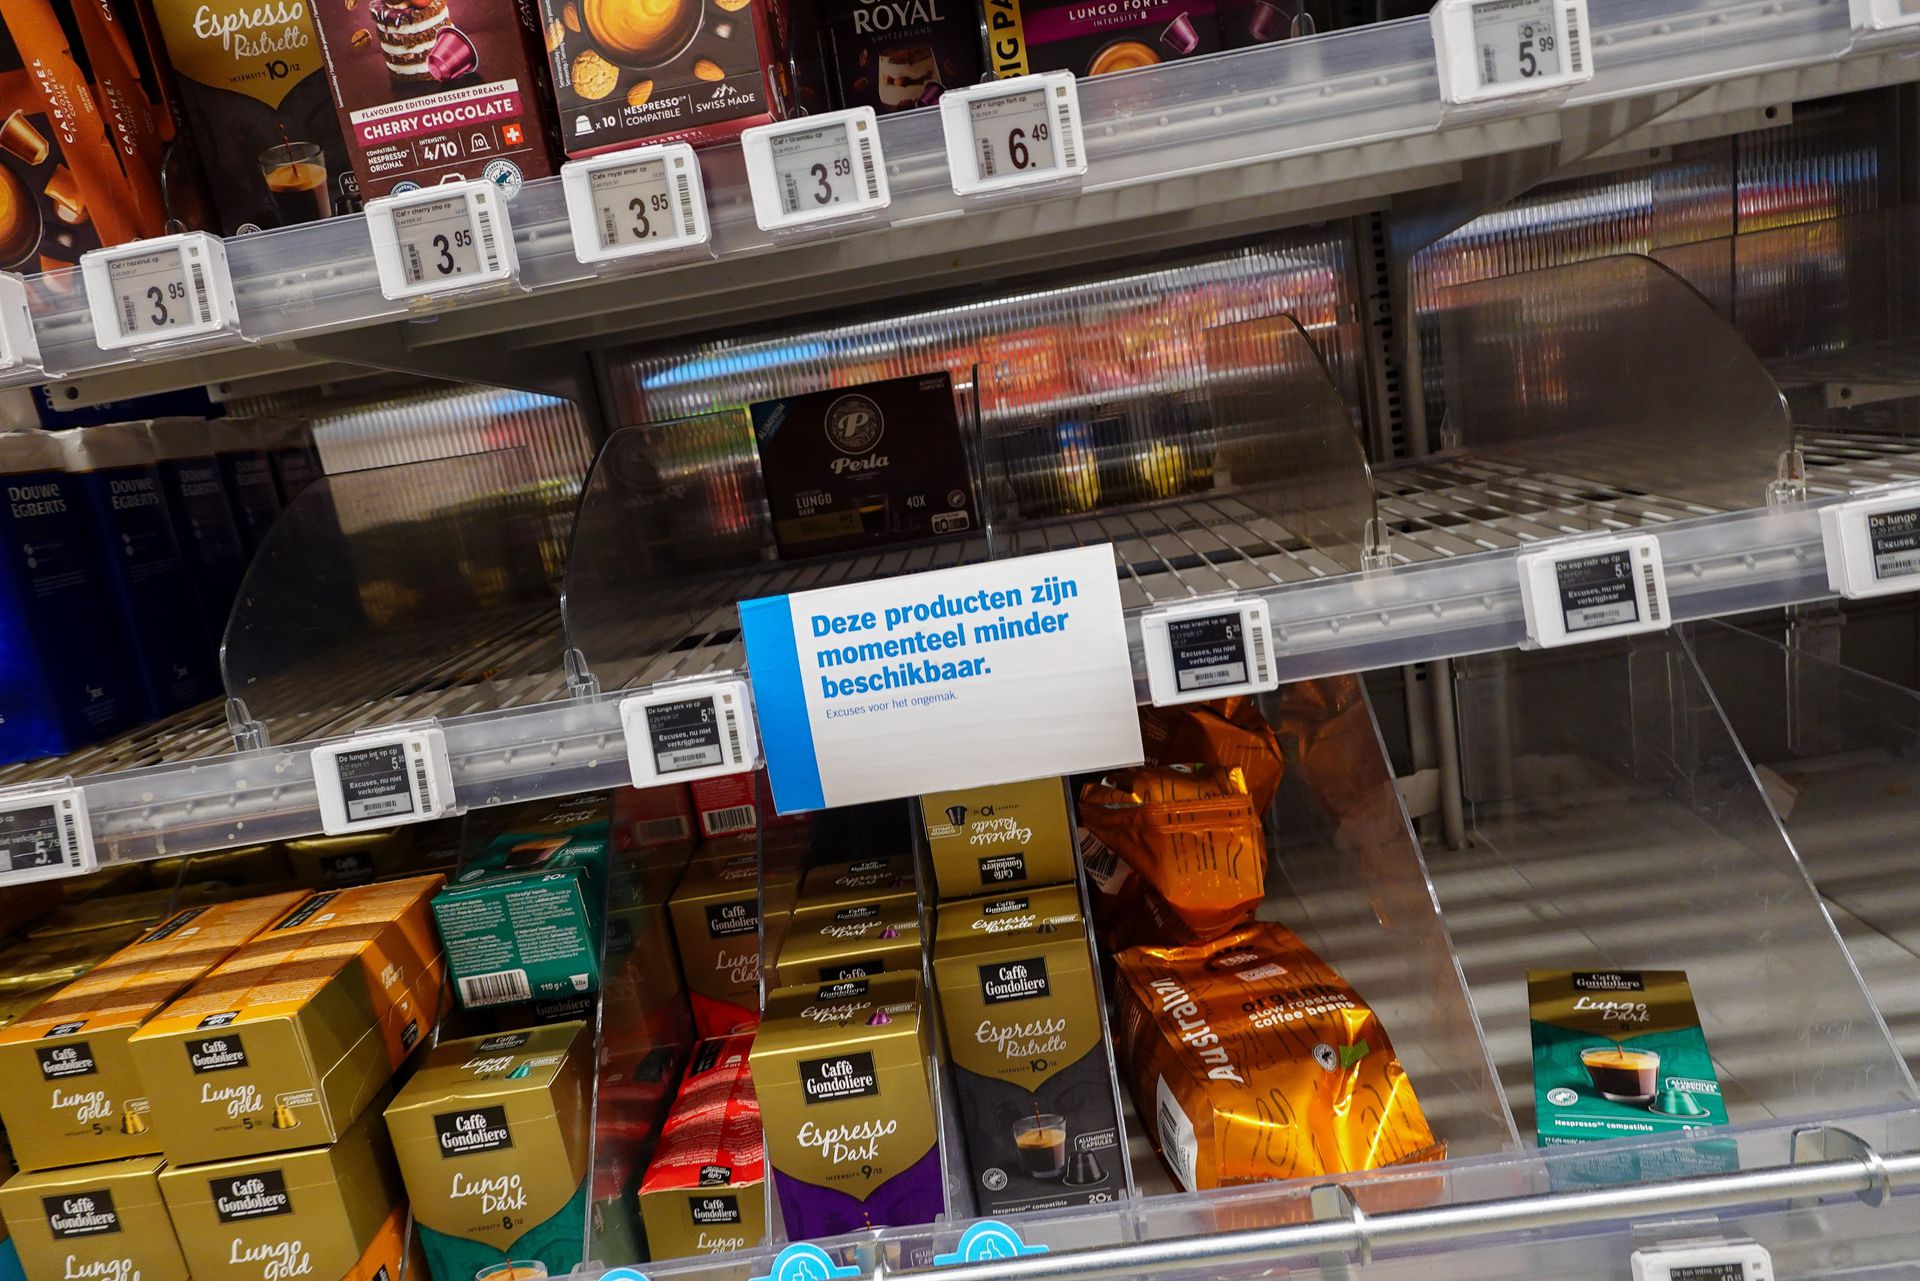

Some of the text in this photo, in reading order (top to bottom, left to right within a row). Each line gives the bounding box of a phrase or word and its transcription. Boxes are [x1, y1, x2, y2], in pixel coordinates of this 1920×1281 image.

[853, 0, 946, 34] ROYAL
[1069, 3, 1117, 21] LUNGO
[1093, 10, 1147, 27] INTENSITY 8
[194, 1, 303, 50] Espresso
[871, 26, 933, 43] SWITZERLAND
[234, 26, 308, 60] Ristretto
[1519, 36, 1554, 77] 5.99
[229, 72, 266, 84] INTENSITY
[33, 59, 73, 143] CARAMEL
[362, 84, 505, 120] FLAVOURED EDITION DESSERT DREAMS
[695, 93, 755, 113] SWISS MADE
[104, 79, 133, 155] CARAMEL
[363, 98, 514, 141] CHERRY CHOCOLATE
[603, 116, 616, 127] 10
[626, 107, 681, 127] COMPATIBLE
[423, 141, 458, 160] 4/10
[474, 139, 484, 148] 10
[1008, 123, 1048, 170] 6.49
[370, 160, 404, 173] ORIGINAL
[811, 158, 850, 204] 3.59
[412, 205, 430, 215] cherry
[629, 193, 668, 238] 3.95
[432, 229, 472, 275] 3.95
[147, 282, 185, 326] 3.95
[838, 412, 869, 437] P
[830, 453, 890, 475] Perla
[10, 499, 67, 519] EGBERTS
[112, 492, 160, 510] EGBERTS
[795, 492, 832, 510] LUNGO
[907, 495, 926, 508] 40X
[1871, 513, 1917, 527] De lungo
[1612, 583, 1626, 592] niet
[811, 575, 1079, 638] Deze producten zijn
[1576, 592, 1620, 606] verkrijgbaar
[817, 609, 1071, 669] momenteel minder
[1180, 648, 1210, 658] Excuses,
[1223, 644, 1236, 653] niet
[1189, 654, 1230, 665] verkrijgbaar
[821, 654, 993, 700] beschikbaar.
[656, 704, 672, 714] lungo
[825, 690, 959, 720] Excuses voor het ongemak.
[659, 731, 689, 742] Excuses,
[698, 727, 712, 735] niet
[666, 737, 706, 748] verkrijgbaar
[339, 748, 398, 763] De lungo vp cp
[350, 774, 402, 789] Excuses, nu niet
[358, 785, 396, 796] verkrijgbaar
[971, 817, 1017, 831] Ristretto
[970, 827, 1033, 845] Espresso
[981, 859, 1023, 871] Gondoliere
[994, 868, 1013, 880] Caffè
[542, 873, 567, 881] 20x
[722, 906, 746, 920] Caffè
[971, 914, 1036, 930] Espresso
[820, 920, 882, 937] Espresso
[999, 965, 1028, 981] Caffè
[985, 976, 1046, 996] Gondoliere
[1576, 978, 1641, 989] Gondoliere
[801, 1001, 872, 1019] Espresso
[1248, 991, 1348, 1022] slow roasted
[1573, 996, 1647, 1013] Lungo
[820, 1012, 854, 1023] Dark
[1254, 1000, 1356, 1030] coffee beans
[1602, 1009, 1651, 1023] Dark
[975, 1018, 1066, 1053] Espresso
[52, 1047, 78, 1062] Caffè
[201, 1040, 228, 1054] Caffè
[1006, 1035, 1067, 1060] Ristretto
[42, 1057, 93, 1074] Gondoliere
[191, 1049, 244, 1068] Gondoliere
[460, 1055, 515, 1070] Lungo
[821, 1060, 854, 1078] Caffè
[200, 1082, 256, 1105] Lungo
[806, 1074, 874, 1095] Gondoliere
[51, 1088, 105, 1110] Lungo
[227, 1096, 264, 1119] Gold
[76, 1103, 114, 1125] Gold
[455, 1114, 487, 1132] Caffè
[1606, 1122, 1654, 1132] compatible
[441, 1127, 508, 1149] Gondoliere
[797, 1119, 898, 1158] Espresso
[1078, 1132, 1115, 1144] ALUMINIUM
[1081, 1139, 1113, 1149] CAPSULES
[833, 1136, 879, 1164] Dark
[231, 1177, 266, 1197] Caffè
[450, 1172, 521, 1201] Lungo
[62, 1197, 96, 1216] Caffè
[217, 1189, 288, 1215] Gondoliere
[482, 1187, 528, 1216] Dark
[703, 1199, 724, 1210] Caffè
[1032, 1200, 1068, 1210] compatible
[50, 1210, 118, 1232] Gondoliere
[693, 1206, 738, 1220] Gondoliere
[696, 1231, 745, 1253] Lungo
[229, 1238, 304, 1265] Lungo
[64, 1254, 133, 1281] Lungo
[263, 1253, 314, 1281] Gold
